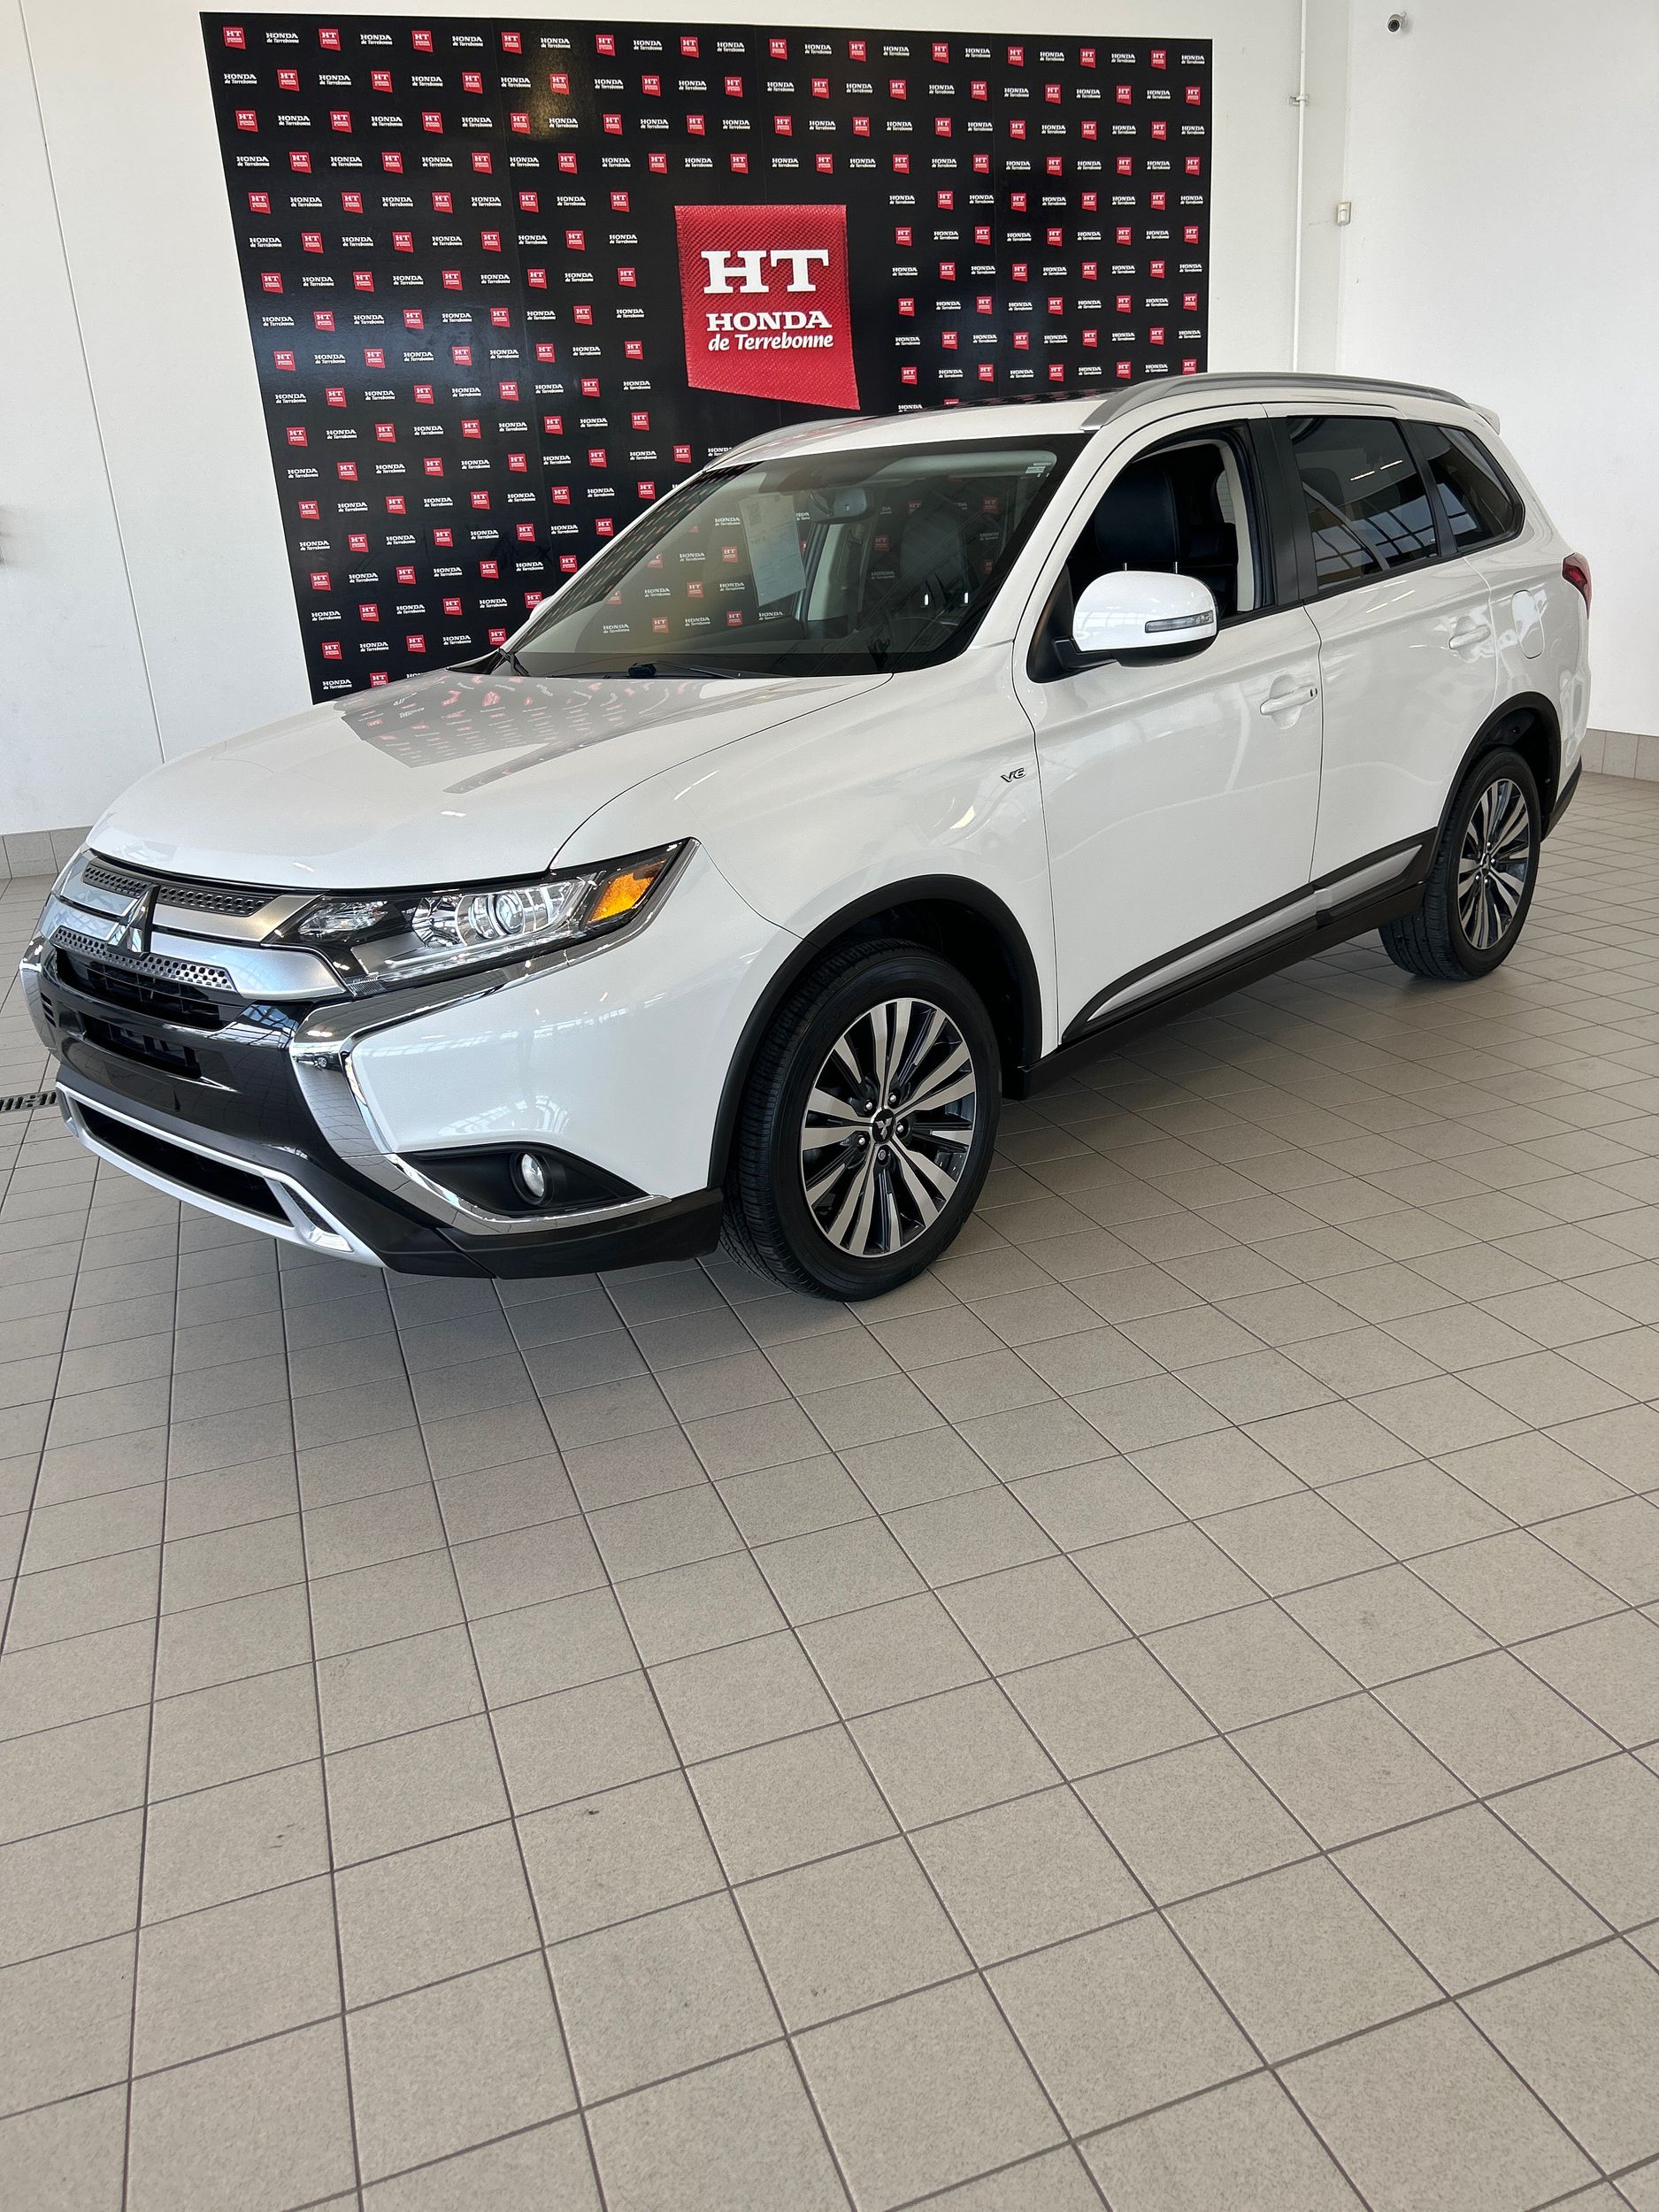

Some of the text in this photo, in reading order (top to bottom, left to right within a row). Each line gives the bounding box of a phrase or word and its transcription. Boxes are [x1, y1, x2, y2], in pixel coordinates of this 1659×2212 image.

[700, 249, 830, 294] HT
[705, 310, 833, 332] HONDA
[708, 332, 833, 351] de Terrebonne
[1000, 767, 1026, 783] V6
